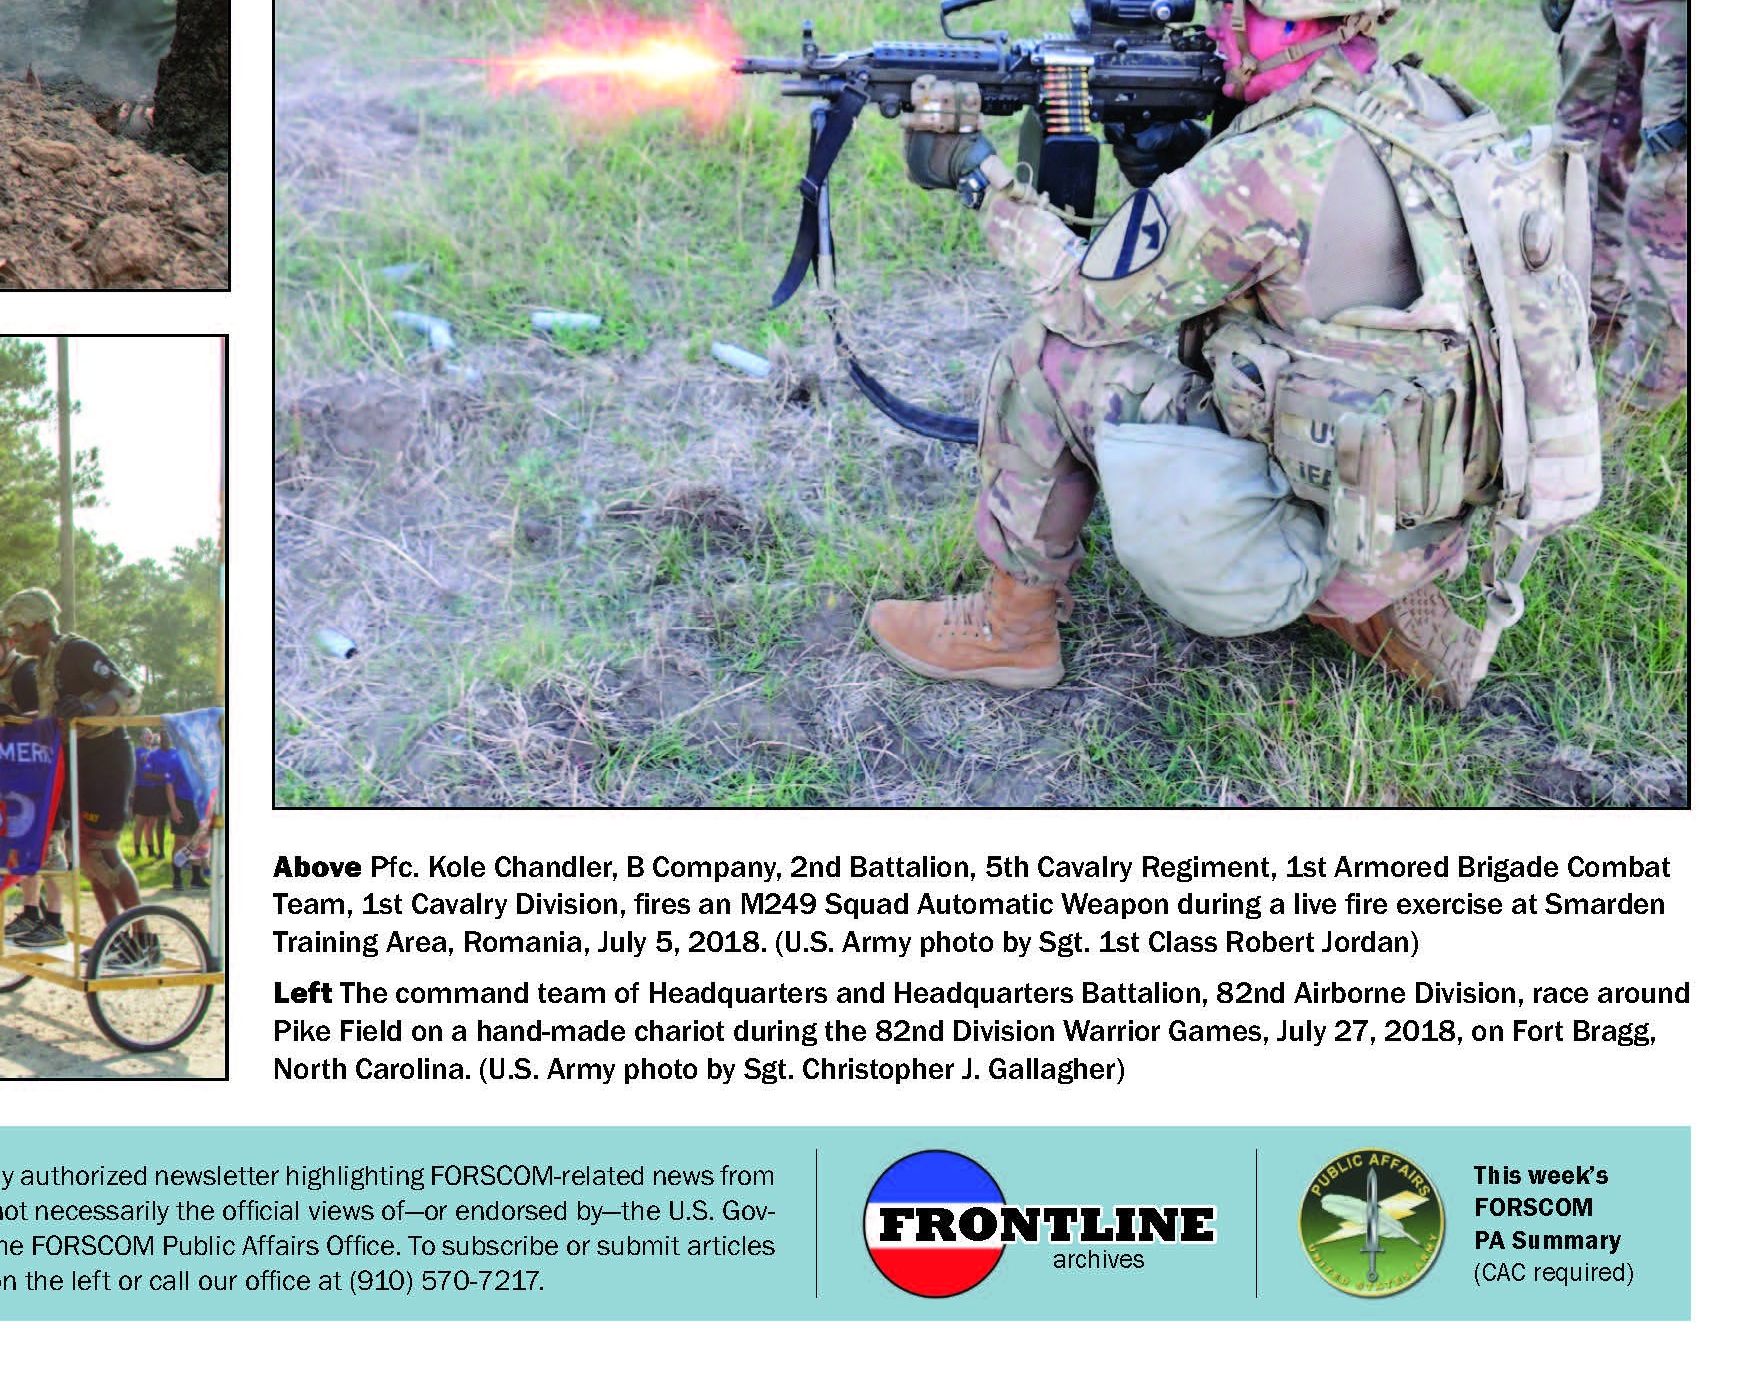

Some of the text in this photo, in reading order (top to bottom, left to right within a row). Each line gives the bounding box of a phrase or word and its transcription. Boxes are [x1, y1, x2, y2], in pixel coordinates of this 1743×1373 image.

[272, 855, 1671, 883] Above Pfc. Kole Chandler, B Company, 2nd Battalion, 5th Cavalry Regiment, 1st Armored Brigade Combat
[274, 980, 1690, 1009] Left The command team of Headquarters and Headquarters Battalion, 82nd Airborne Division, race around
[20, 1165, 147, 1186] authorized
[155, 1165, 280, 1186] newsletter
[286, 1165, 425, 1191] highlighting
[431, 1164, 644, 1186] FORSCOM-related
[653, 1169, 715, 1186] news
[719, 1164, 774, 1186] from
[1311, 1153, 1431, 1197] PUBLIC AFFAIRS
[1473, 1165, 1609, 1185] This week’s
[1475, 1197, 1593, 1217] FORSCOM
[878, 1206, 1215, 1243] FRONTLINE
[1475, 1230, 1622, 1255] PA Summary
[1053, 1249, 1145, 1269] archives
[1474, 1262, 1634, 1287] (CAC required)
